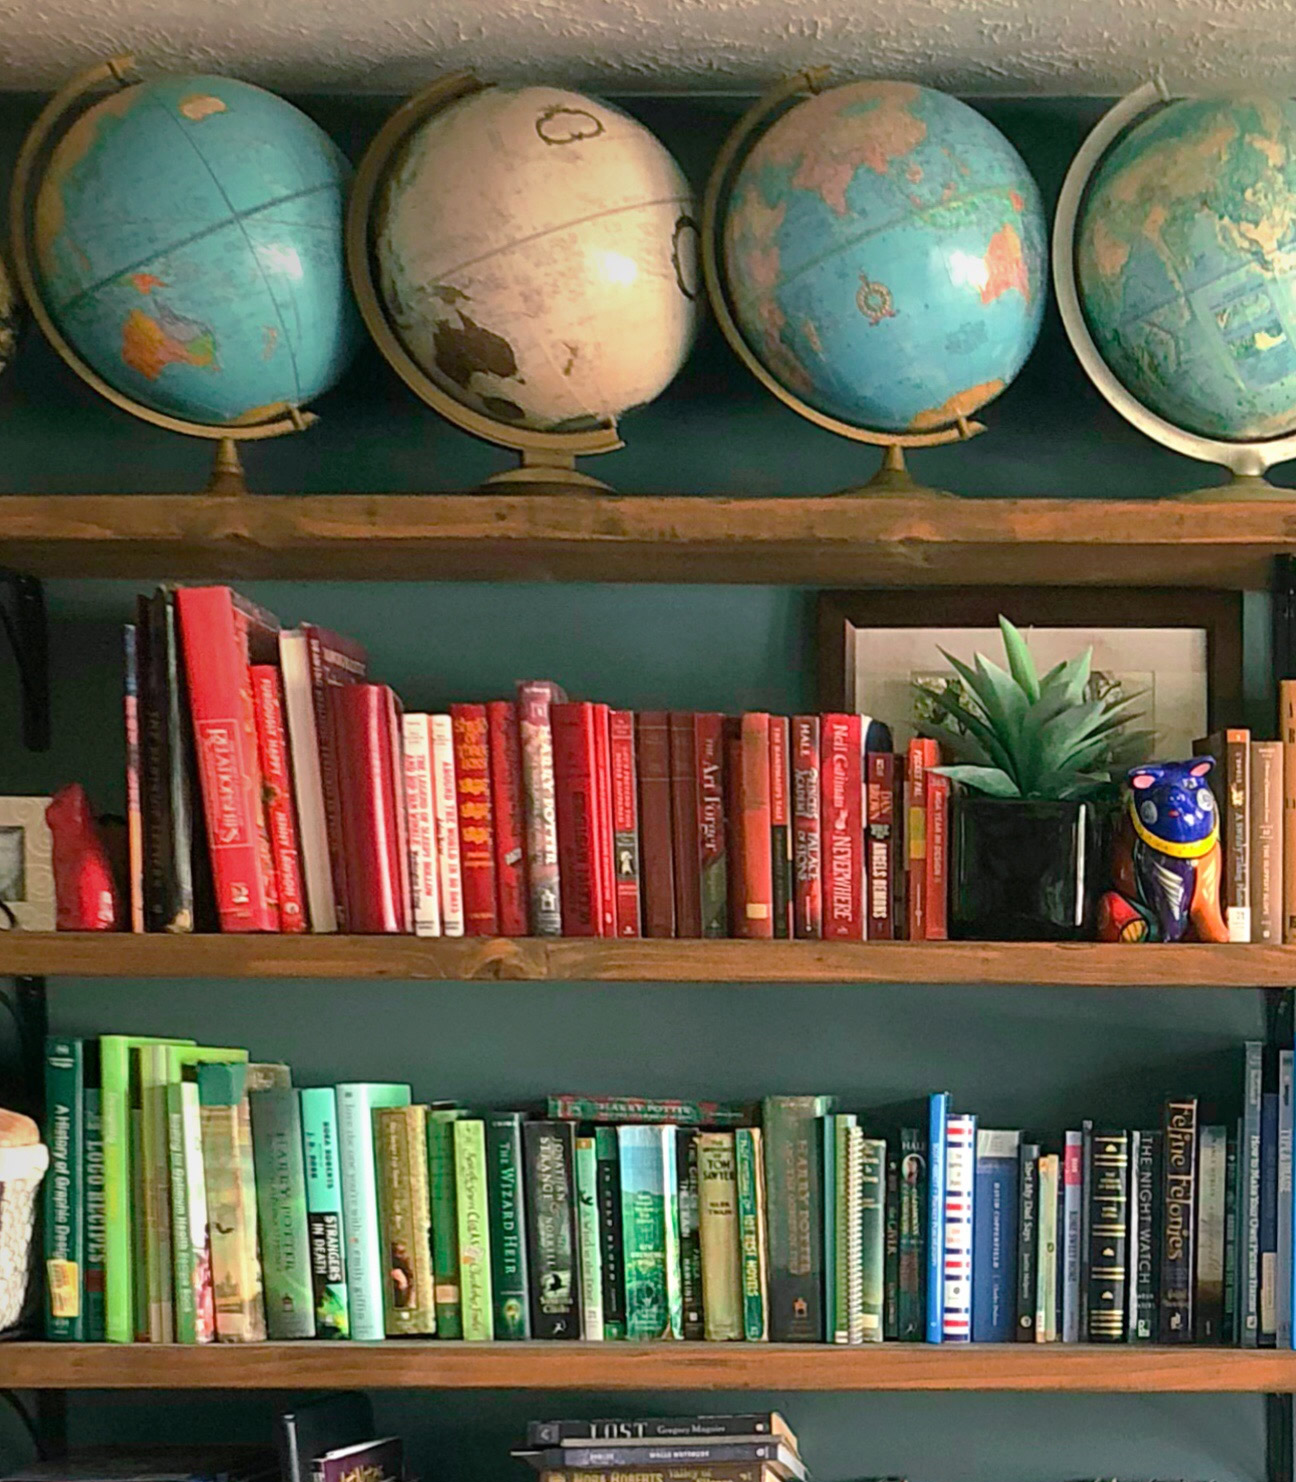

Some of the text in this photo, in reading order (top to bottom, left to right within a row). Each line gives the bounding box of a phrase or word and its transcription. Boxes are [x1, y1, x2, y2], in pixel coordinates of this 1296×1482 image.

[261, 678, 281, 774] FURIOUSLY HAPPY
[538, 725, 555, 792] HARRY
[800, 724, 810, 757] HALE
[703, 760, 719, 789] Art
[832, 725, 849, 808] Neil Gaiman
[274, 812, 298, 896] JENNY LAWSON
[544, 798, 558, 864] POTTER
[701, 796, 721, 852] Forger
[833, 836, 852, 922] NEVERWHERE
[872, 842, 887, 919] ANGELS DEMONS
[55, 1116, 70, 1158] History
[57, 1105, 70, 1114] A
[53, 1176, 70, 1222] Graphic
[57, 1161, 70, 1173] of
[539, 1137, 554, 1200] STRANGE
[551, 1137, 565, 1202] JONATHAN
[1167, 1102, 1193, 1260] Feline Felonies
[500, 1142, 517, 1274] THE WIZARD HEIR
[1138, 1137, 1153, 1283] THE NIGHT WATCH
[54, 1225, 70, 1261] Desig
[312, 1223, 326, 1274] IN DEATH
[325, 1215, 340, 1281] STRANGERS
[744, 1214, 757, 1297] 101 BEST NOVELS
